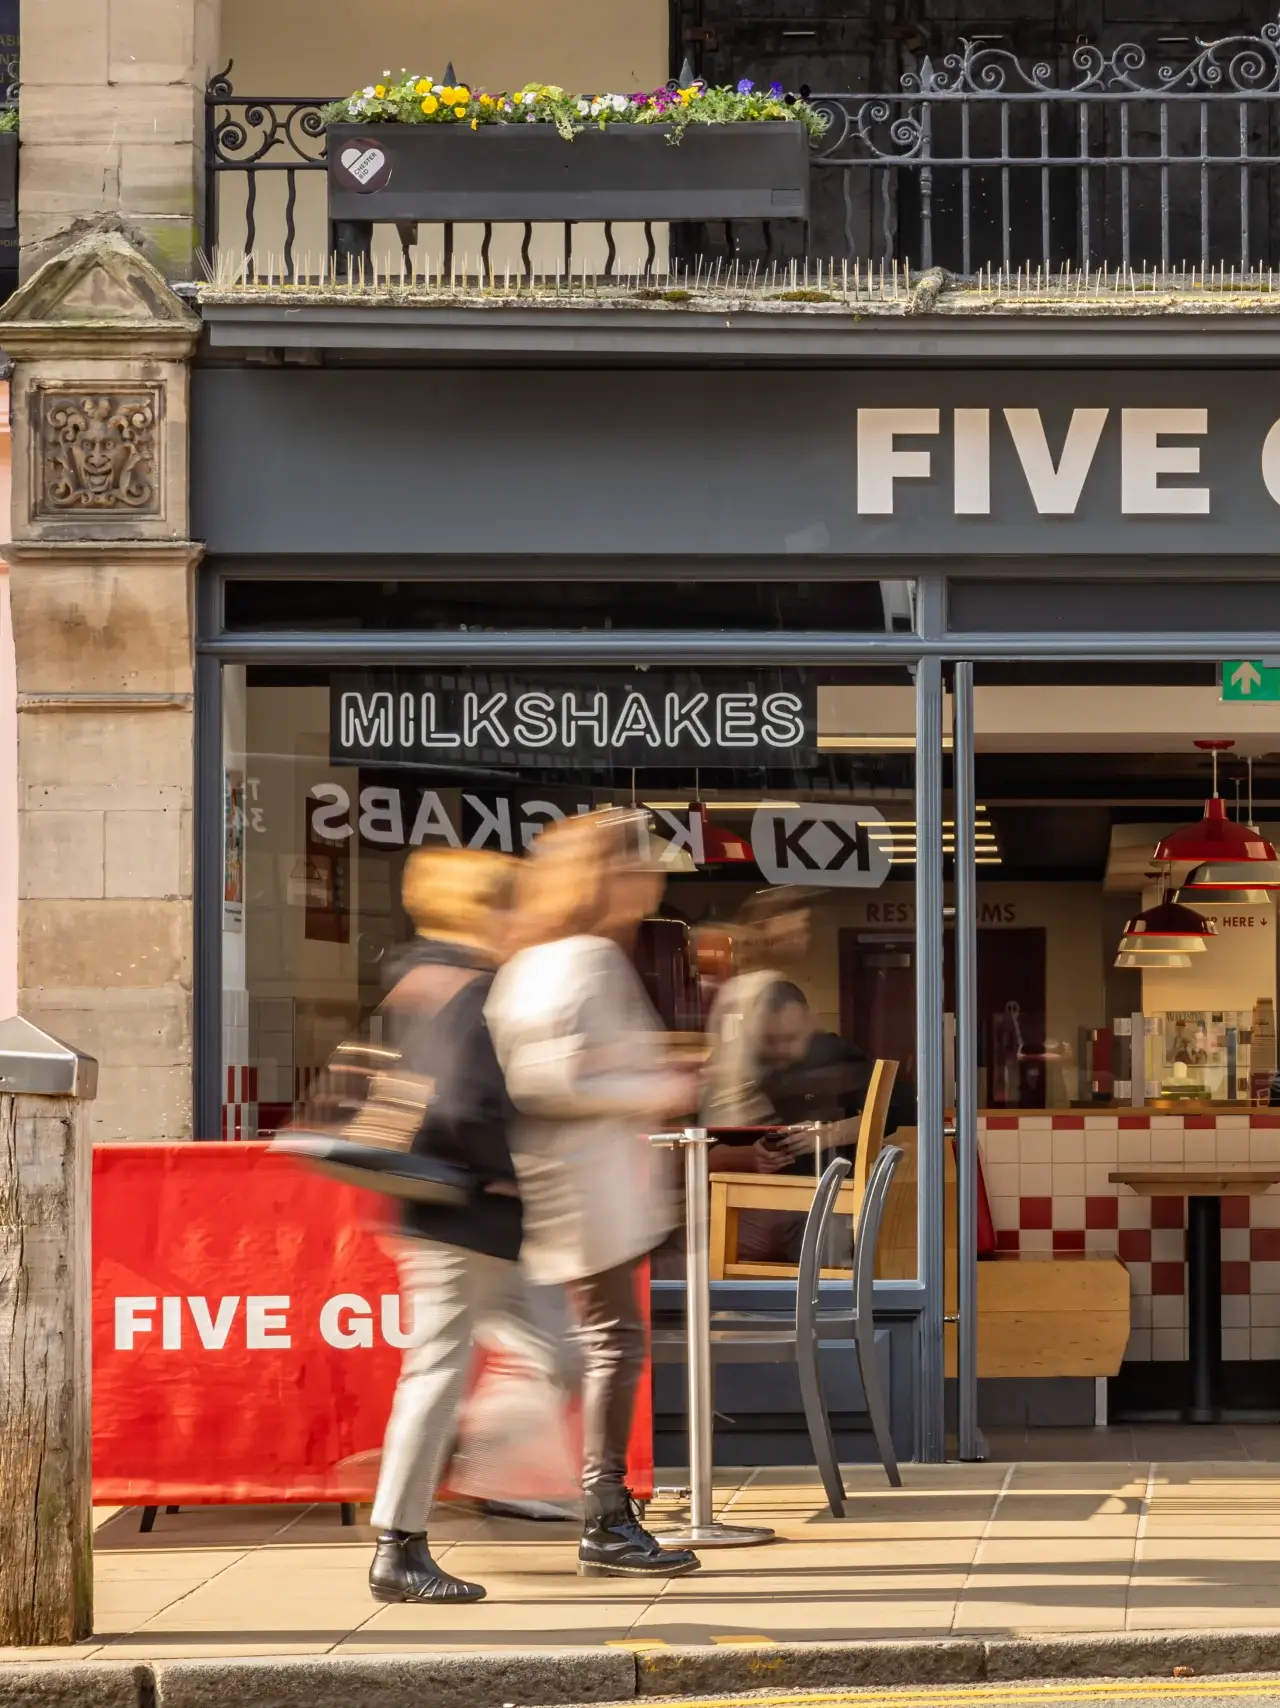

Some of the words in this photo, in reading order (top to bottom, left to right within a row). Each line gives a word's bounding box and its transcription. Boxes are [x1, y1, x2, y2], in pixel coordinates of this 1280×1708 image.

[354, 152, 377, 175] CHESTER
[856, 407, 1210, 515] FIVE
[340, 692, 804, 748] MILKSHAKES
[1223, 916, 1255, 927] HERE
[114, 1295, 291, 1350] FIVE
